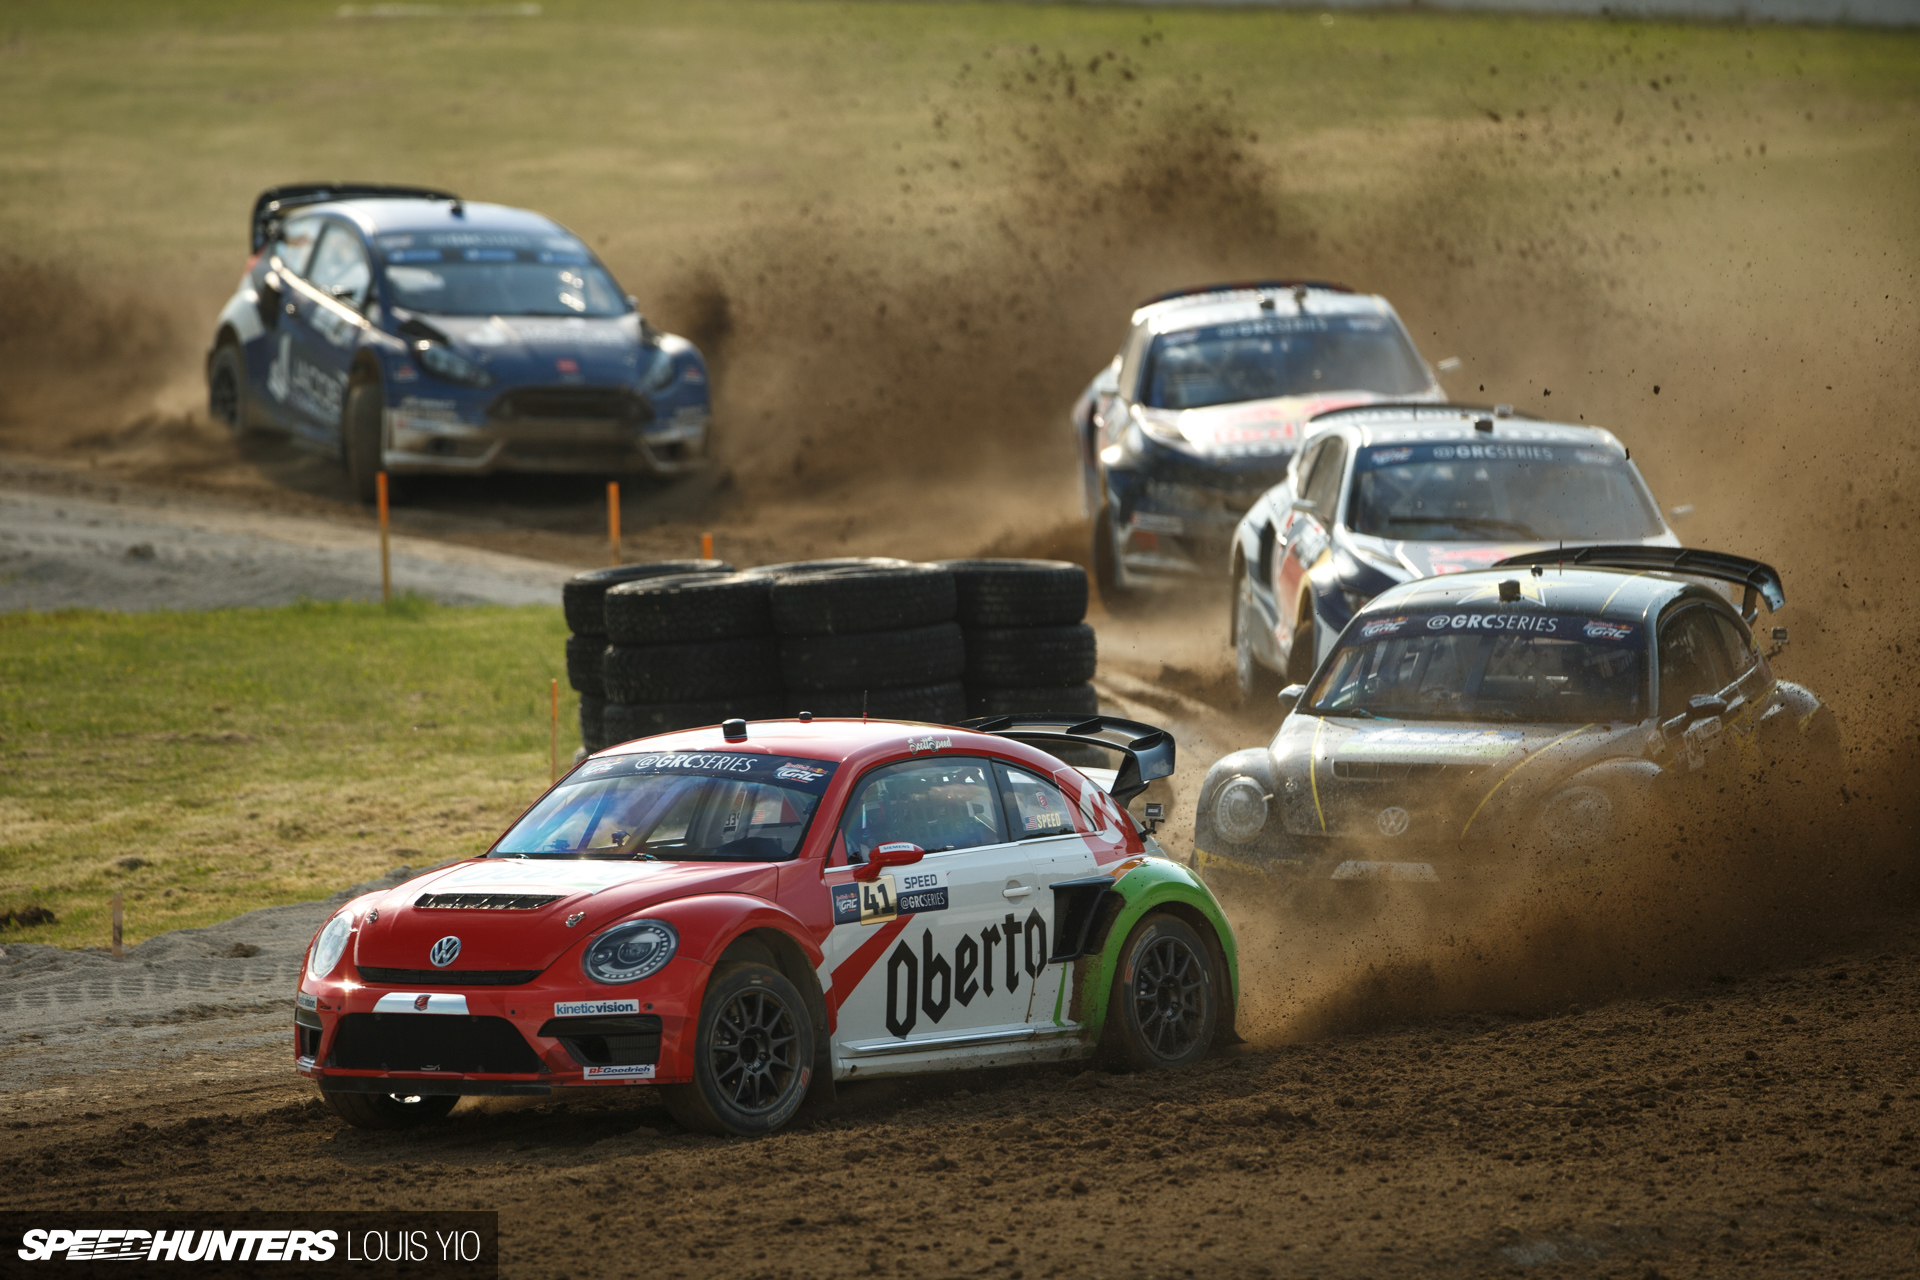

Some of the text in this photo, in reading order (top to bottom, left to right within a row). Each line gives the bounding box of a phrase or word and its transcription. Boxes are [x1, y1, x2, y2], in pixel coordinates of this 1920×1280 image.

[1426, 614, 1559, 633] @GRCSERIES
[634, 754, 758, 773] @GRCSERIES
[1036, 812, 1062, 829] SPEED
[904, 874, 938, 889] SPEED
[841, 898, 858, 911] GRC
[863, 883, 895, 915] 41
[900, 892, 945, 910] @GRCSERIES
[885, 907, 1047, 1040] Oberto
[588, 1066, 651, 1074] BFGoodrich
